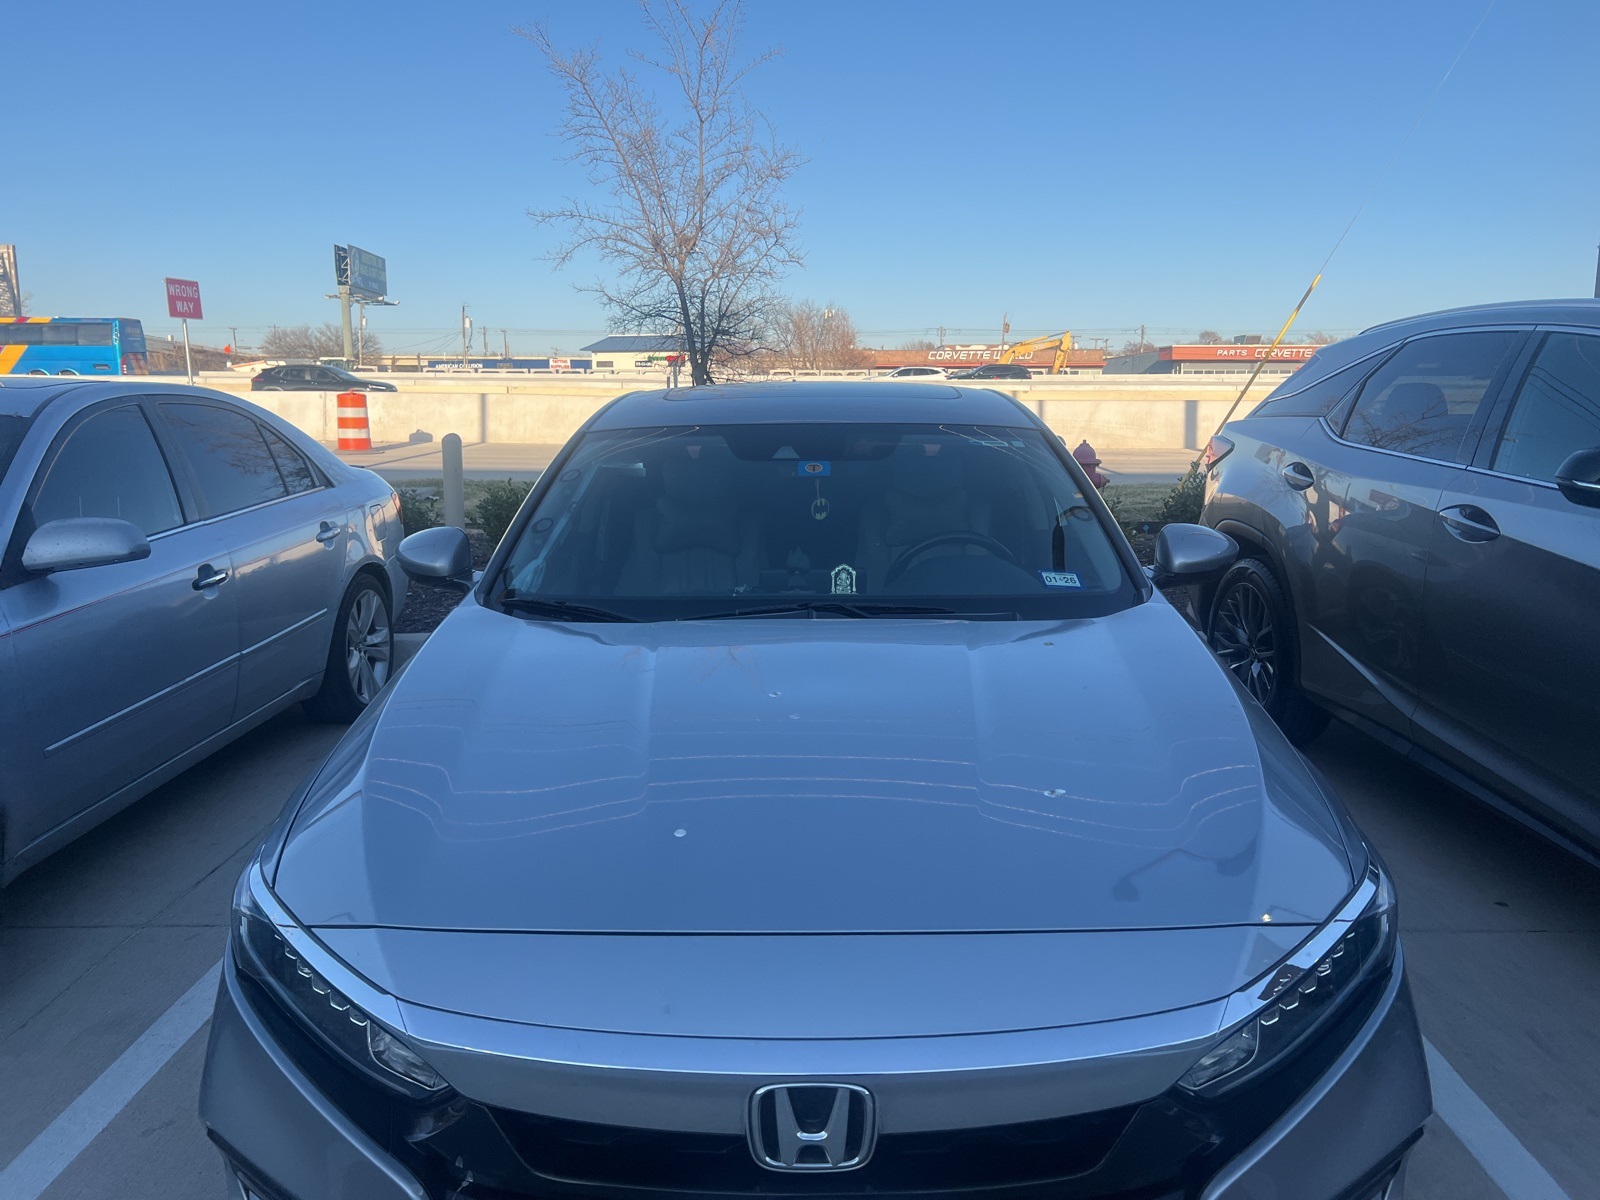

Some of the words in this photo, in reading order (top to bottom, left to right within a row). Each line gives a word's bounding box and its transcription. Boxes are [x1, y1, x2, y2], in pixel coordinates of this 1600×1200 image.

[168, 284, 199, 298] WRONG
[176, 301, 194, 313] WAY
[928, 350, 991, 360] CORVETTE
[993, 350, 1034, 360] WLD
